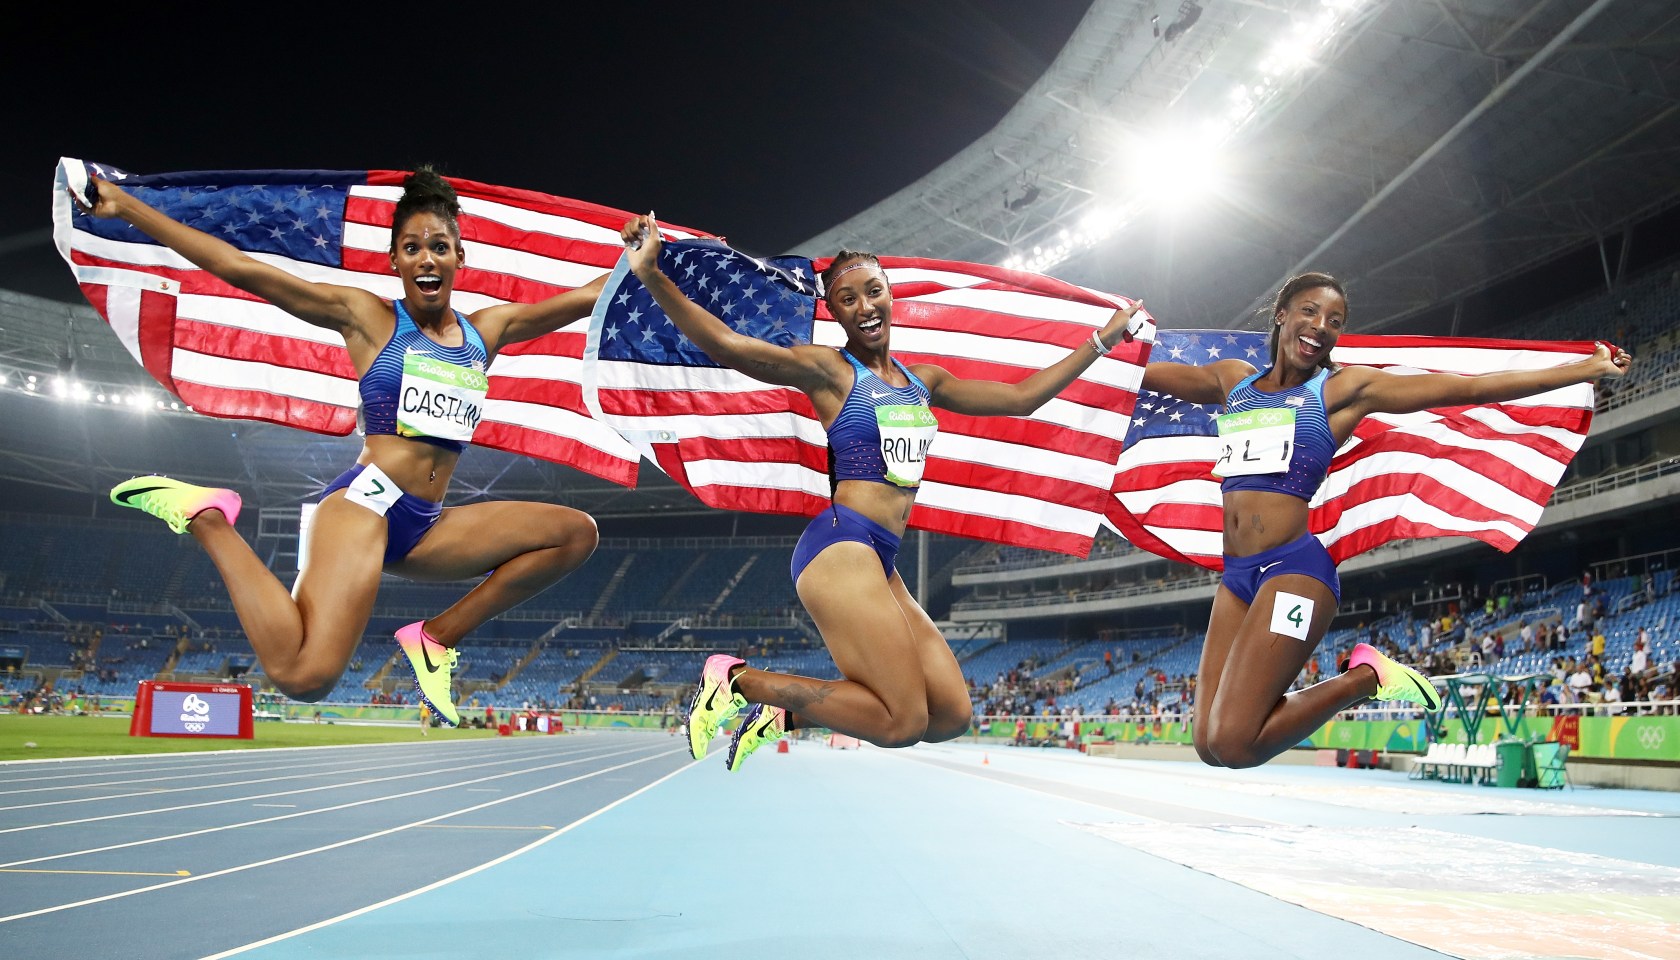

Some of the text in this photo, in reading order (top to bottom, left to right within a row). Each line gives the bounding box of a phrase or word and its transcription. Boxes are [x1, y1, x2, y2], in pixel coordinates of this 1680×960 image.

[418, 362, 456, 380] Rio2016
[364, 478, 385, 496] 7
[1287, 604, 1303, 628] 4
